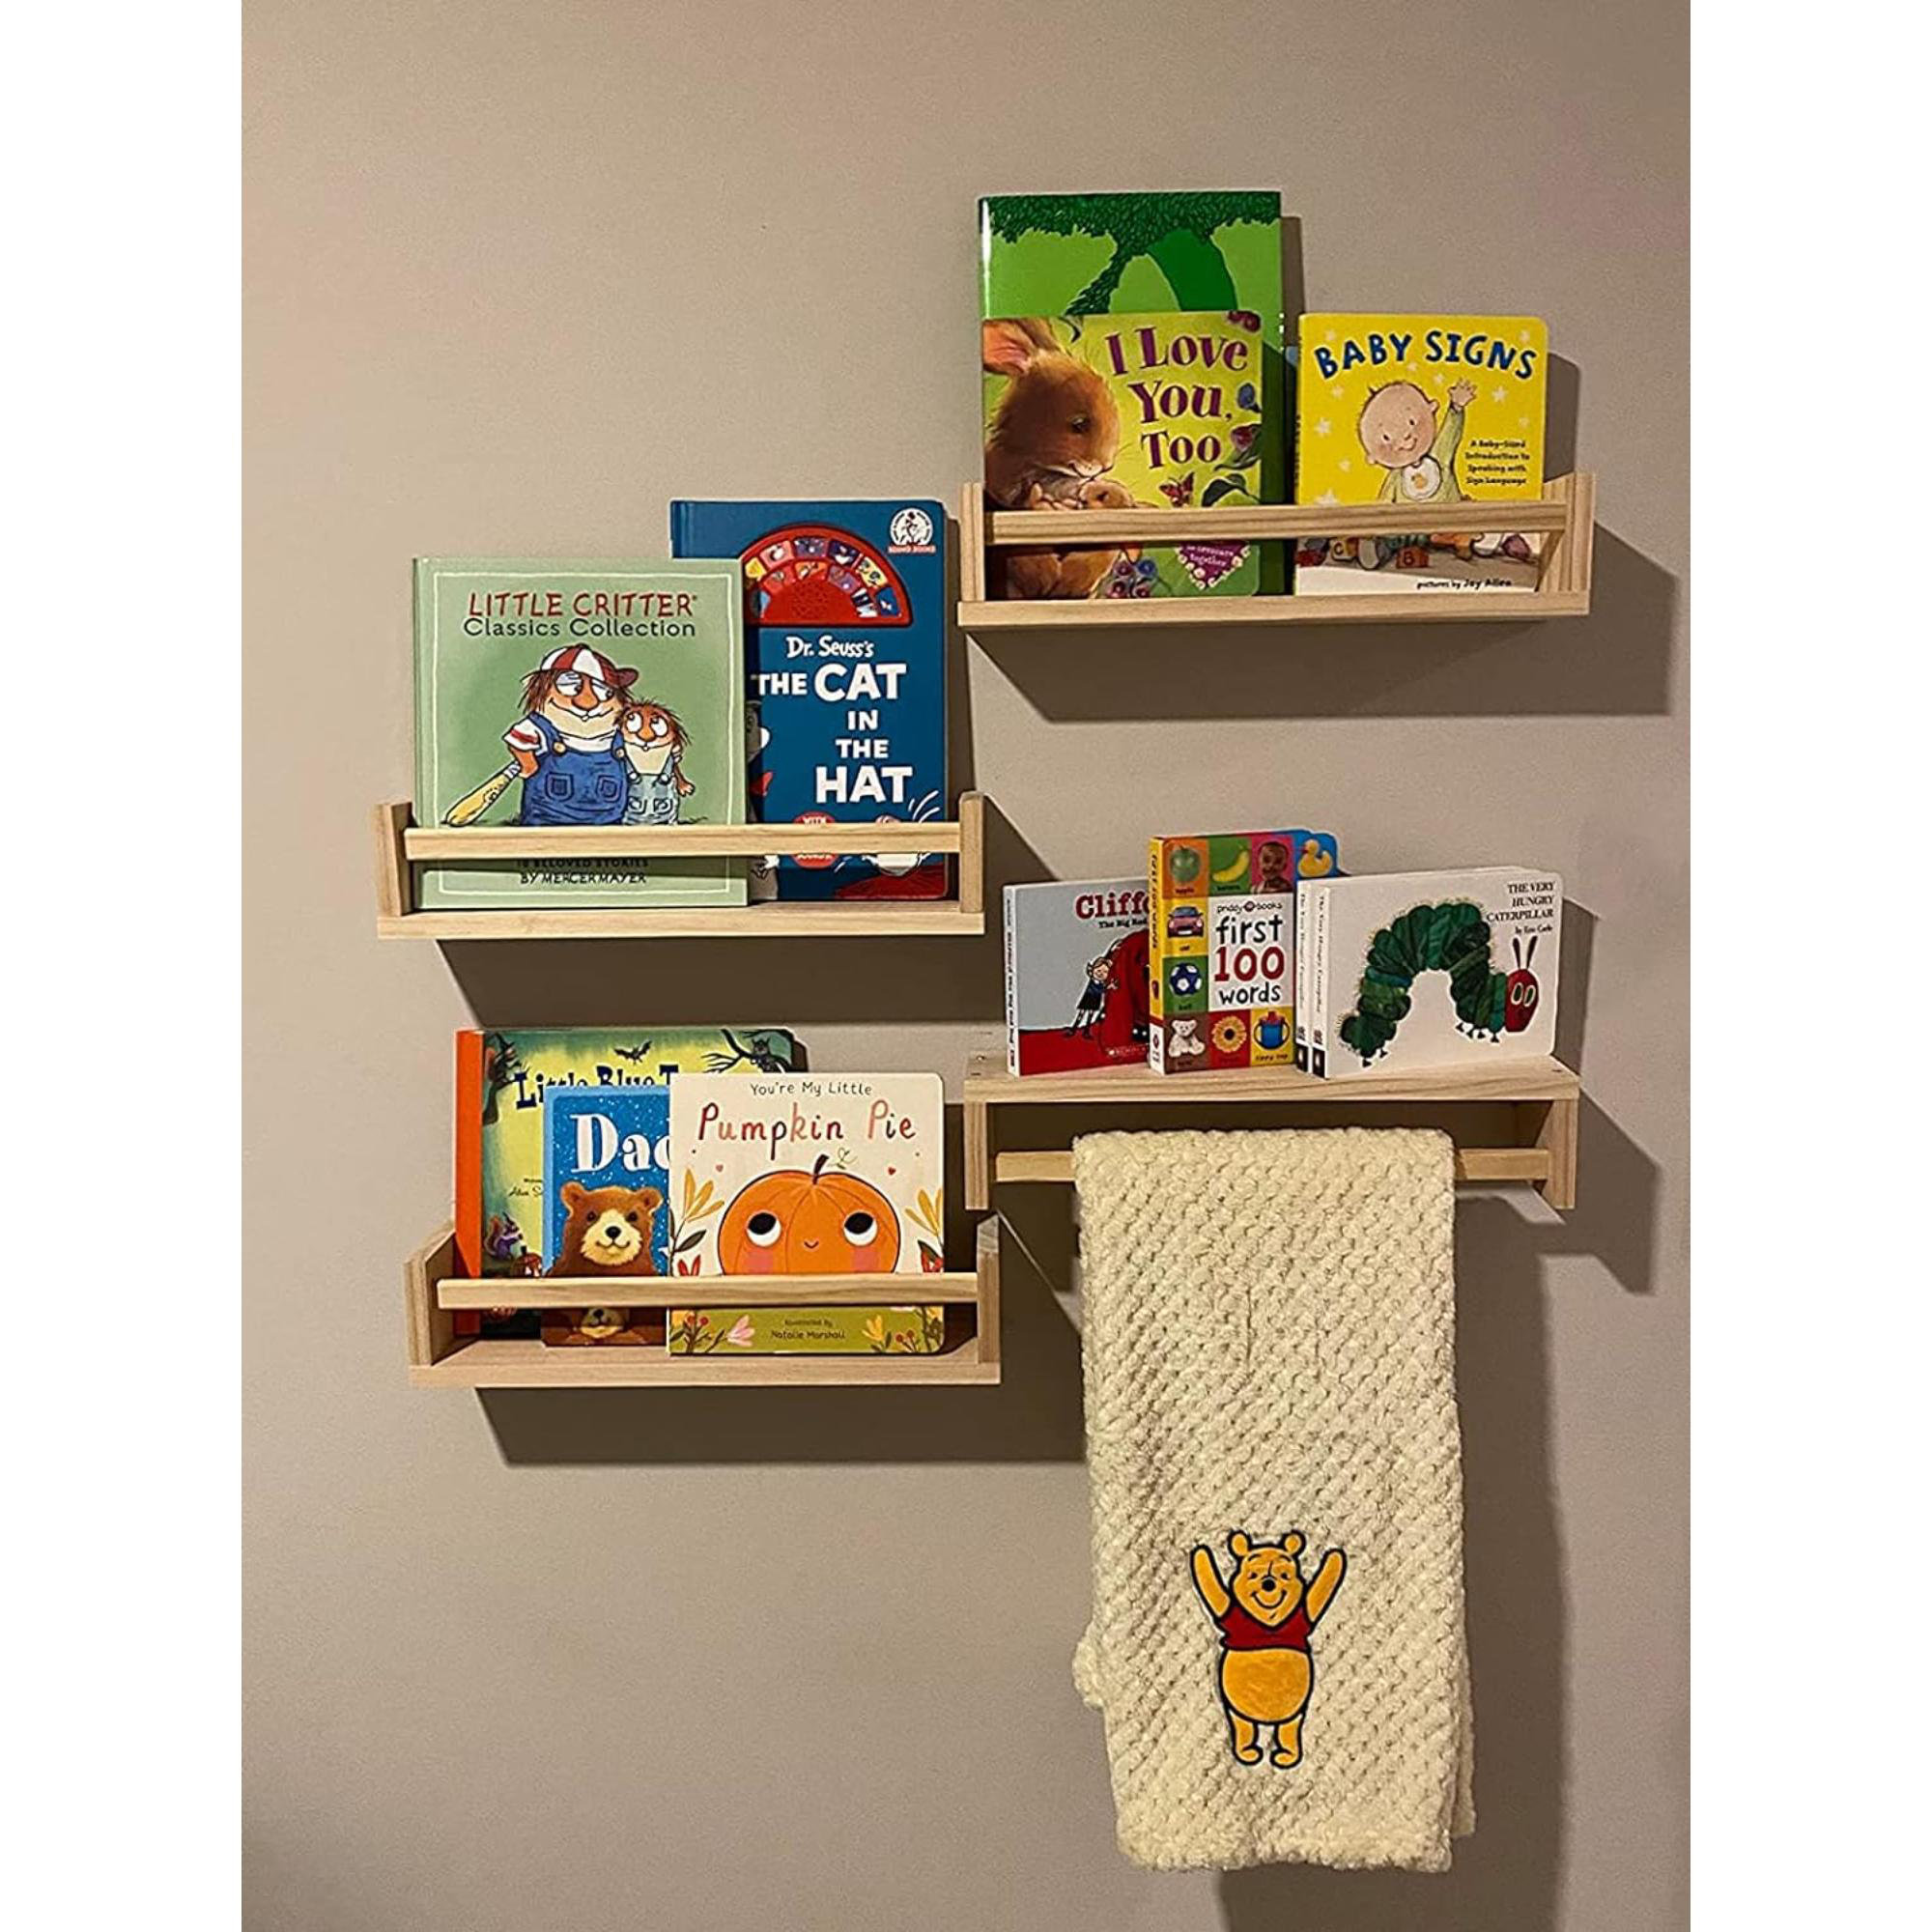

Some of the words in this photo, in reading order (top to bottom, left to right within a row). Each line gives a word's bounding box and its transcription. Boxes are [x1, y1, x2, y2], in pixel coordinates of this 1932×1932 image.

[1105, 333, 1128, 376] I
[1134, 327, 1248, 372] Love
[1314, 332, 1412, 380] BABY
[1425, 329, 1537, 380] SIGNS
[1127, 380, 1233, 424] You,
[1140, 430, 1221, 469] Too
[469, 591, 564, 617] LITTLE
[464, 617, 560, 638] Classics
[569, 617, 696, 638] Collection
[785, 636, 815, 659] Dr.
[817, 635, 875, 659] Seuss's
[751, 671, 808, 696] THE
[814, 662, 907, 702] CAT
[847, 709, 879, 731] IN
[835, 738, 890, 759] THE
[815, 764, 914, 804] HAT
[520, 872, 540, 884] BY
[541, 872, 596, 884] MERCER
[598, 872, 647, 884] MAYER
[1507, 883, 1529, 894] THE
[1486, 908, 1554, 923] CATERPILLAR
[1215, 914, 1284, 945] first
[1214, 946, 1285, 982] 100
[1218, 980, 1282, 1005] words
[750, 1081, 795, 1096] You're
[801, 1081, 822, 1097] My
[828, 1081, 873, 1096] Little
[697, 1101, 844, 1161] Pumpkin
[867, 1099, 916, 1141] Pie
[806, 1329, 846, 1340] Marshall
